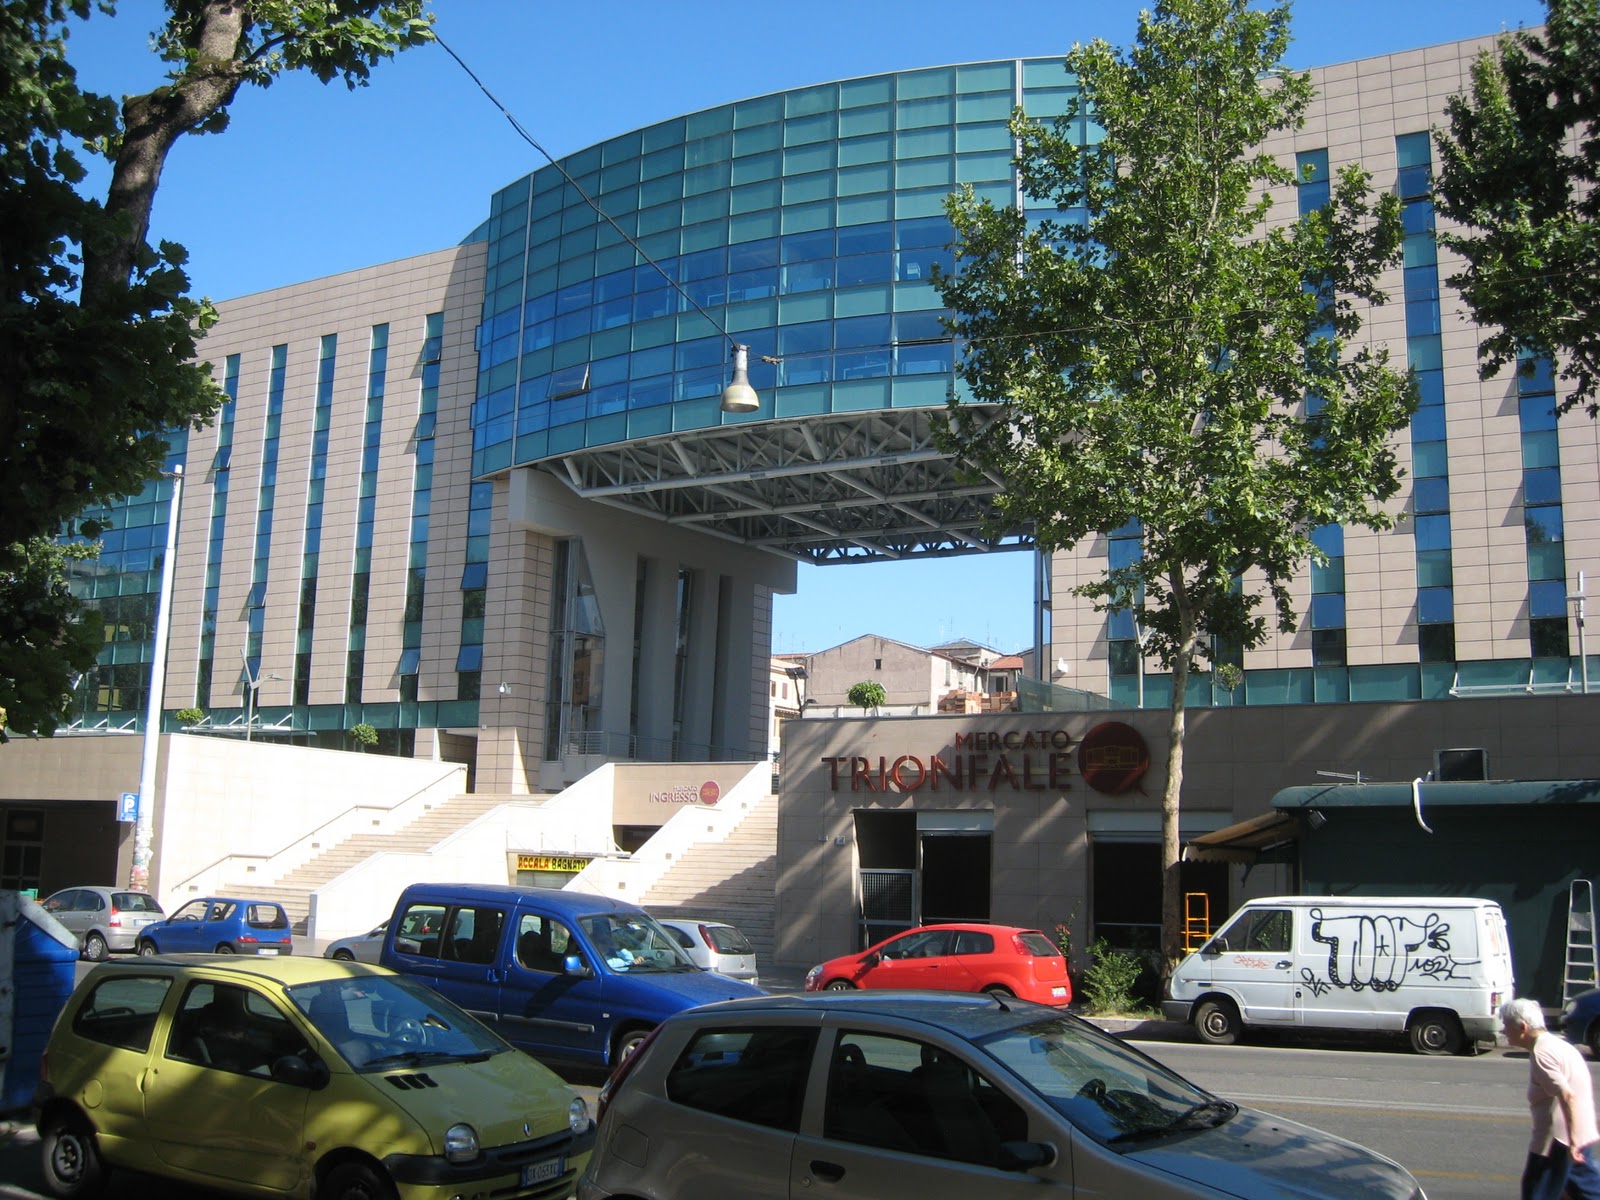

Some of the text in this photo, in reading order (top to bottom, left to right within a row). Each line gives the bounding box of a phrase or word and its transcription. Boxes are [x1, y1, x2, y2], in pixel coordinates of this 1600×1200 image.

[955, 729, 1071, 751] MERCATO
[821, 753, 1072, 793] TRIONFALE
[649, 792, 698, 803] INGRESSO
[551, 858, 585, 870] BAGNATO
